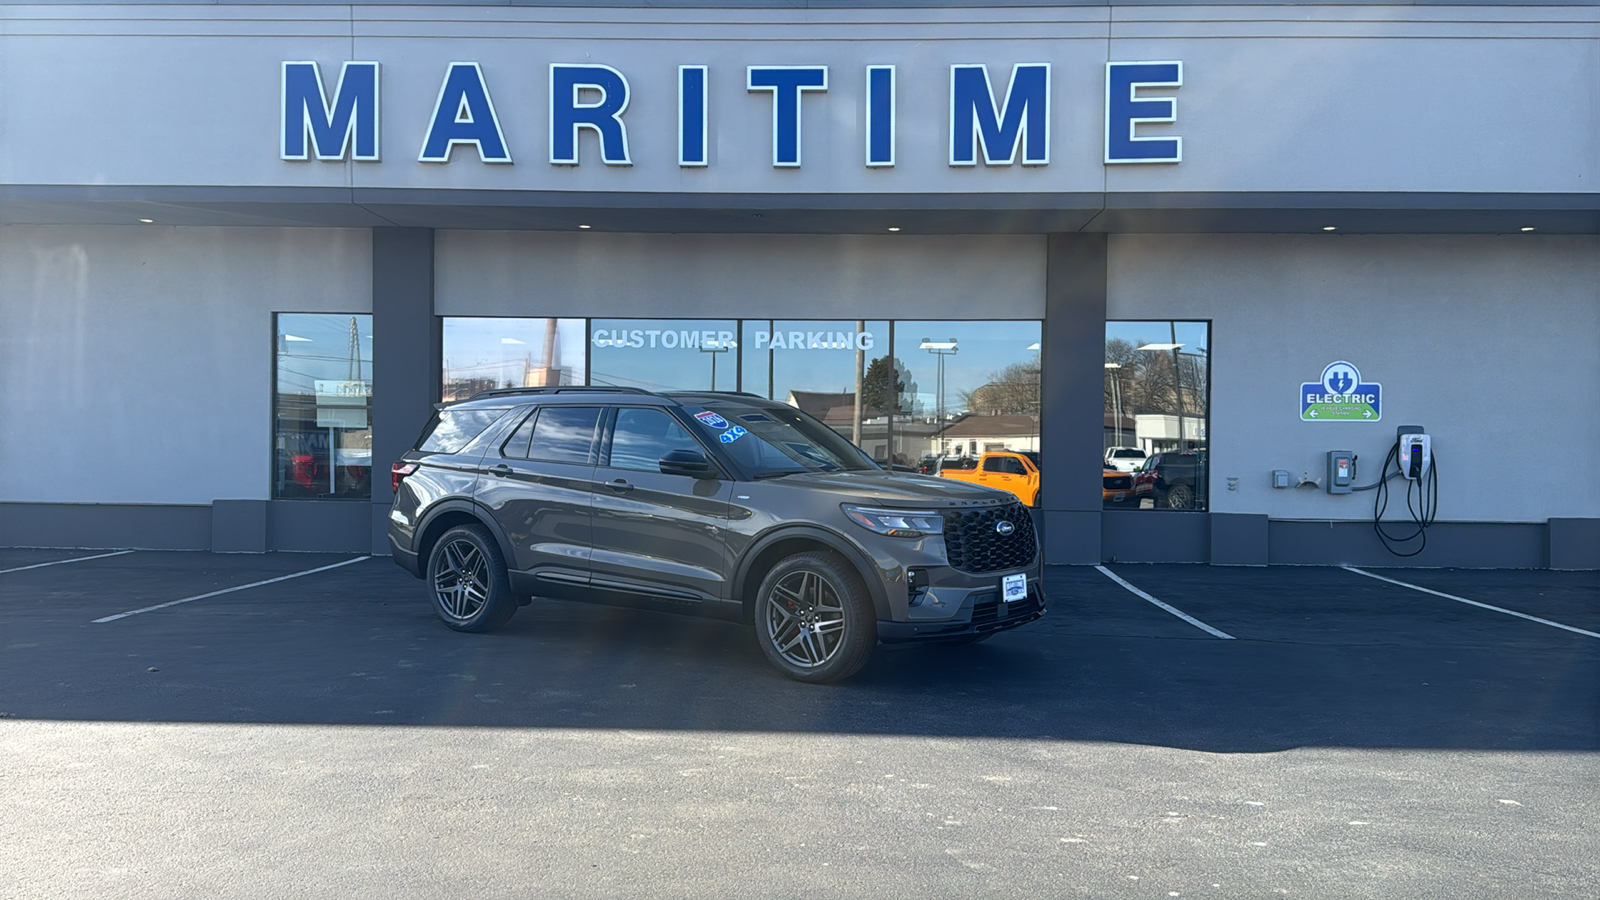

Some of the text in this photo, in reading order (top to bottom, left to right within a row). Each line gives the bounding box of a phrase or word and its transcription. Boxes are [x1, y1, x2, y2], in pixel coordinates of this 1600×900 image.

[280, 60, 1183, 168] MARITIME
[593, 329, 874, 350] CUSTOMER PARKING
[1306, 393, 1376, 404] ELECTRIC
